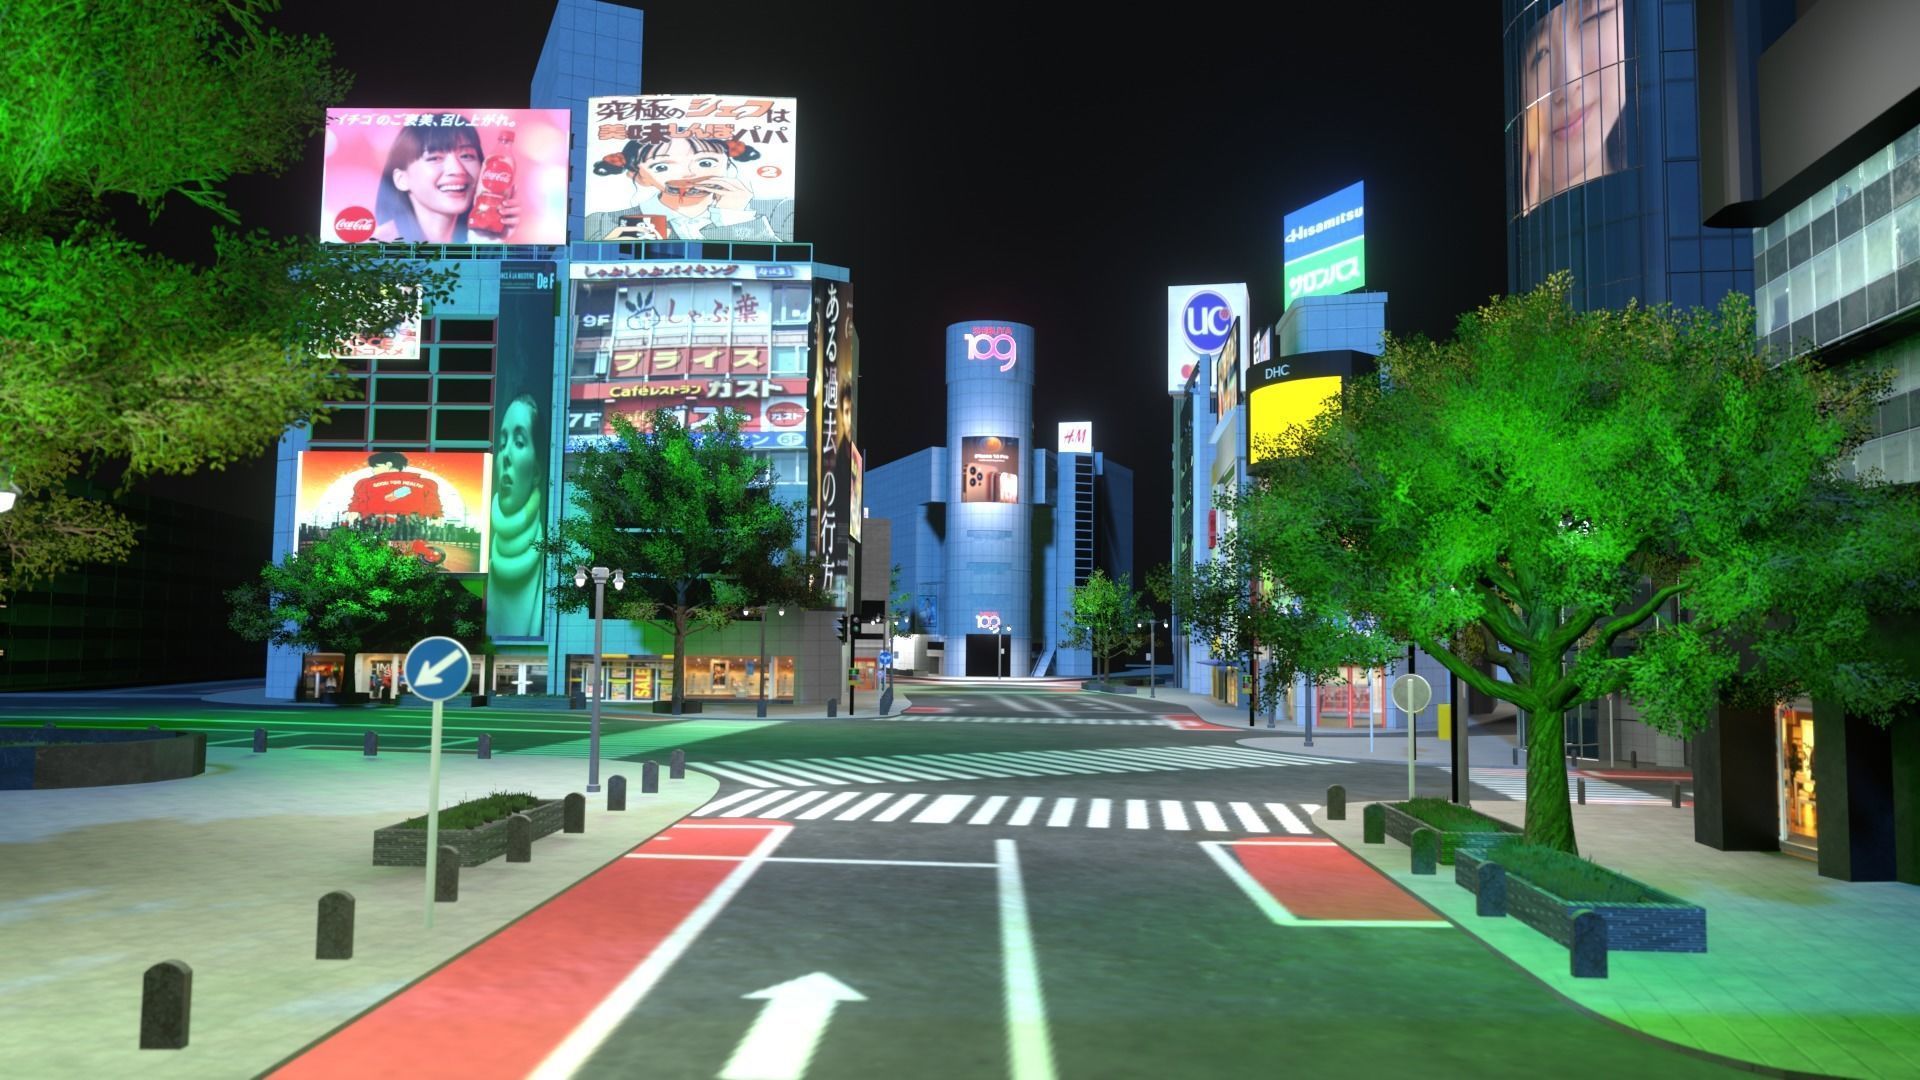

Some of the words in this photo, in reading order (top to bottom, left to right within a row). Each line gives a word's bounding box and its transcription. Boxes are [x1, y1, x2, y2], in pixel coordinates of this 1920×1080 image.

[596, 97, 791, 123] 究極のシェフは
[1284, 206, 1364, 243] Hisamitsu
[1288, 256, 1361, 299] サロンパス
[667, 293, 760, 324] しゃぶ葉
[582, 313, 611, 328] 9F
[964, 333, 1017, 373] 109
[1265, 364, 1291, 380] DHC
[706, 379, 783, 398] ガスト
[569, 412, 603, 428] 7F
[771, 412, 803, 422] ガスト
[780, 435, 801, 445] 6F
[975, 614, 1001, 634] 109
[634, 667, 652, 698] SALE
